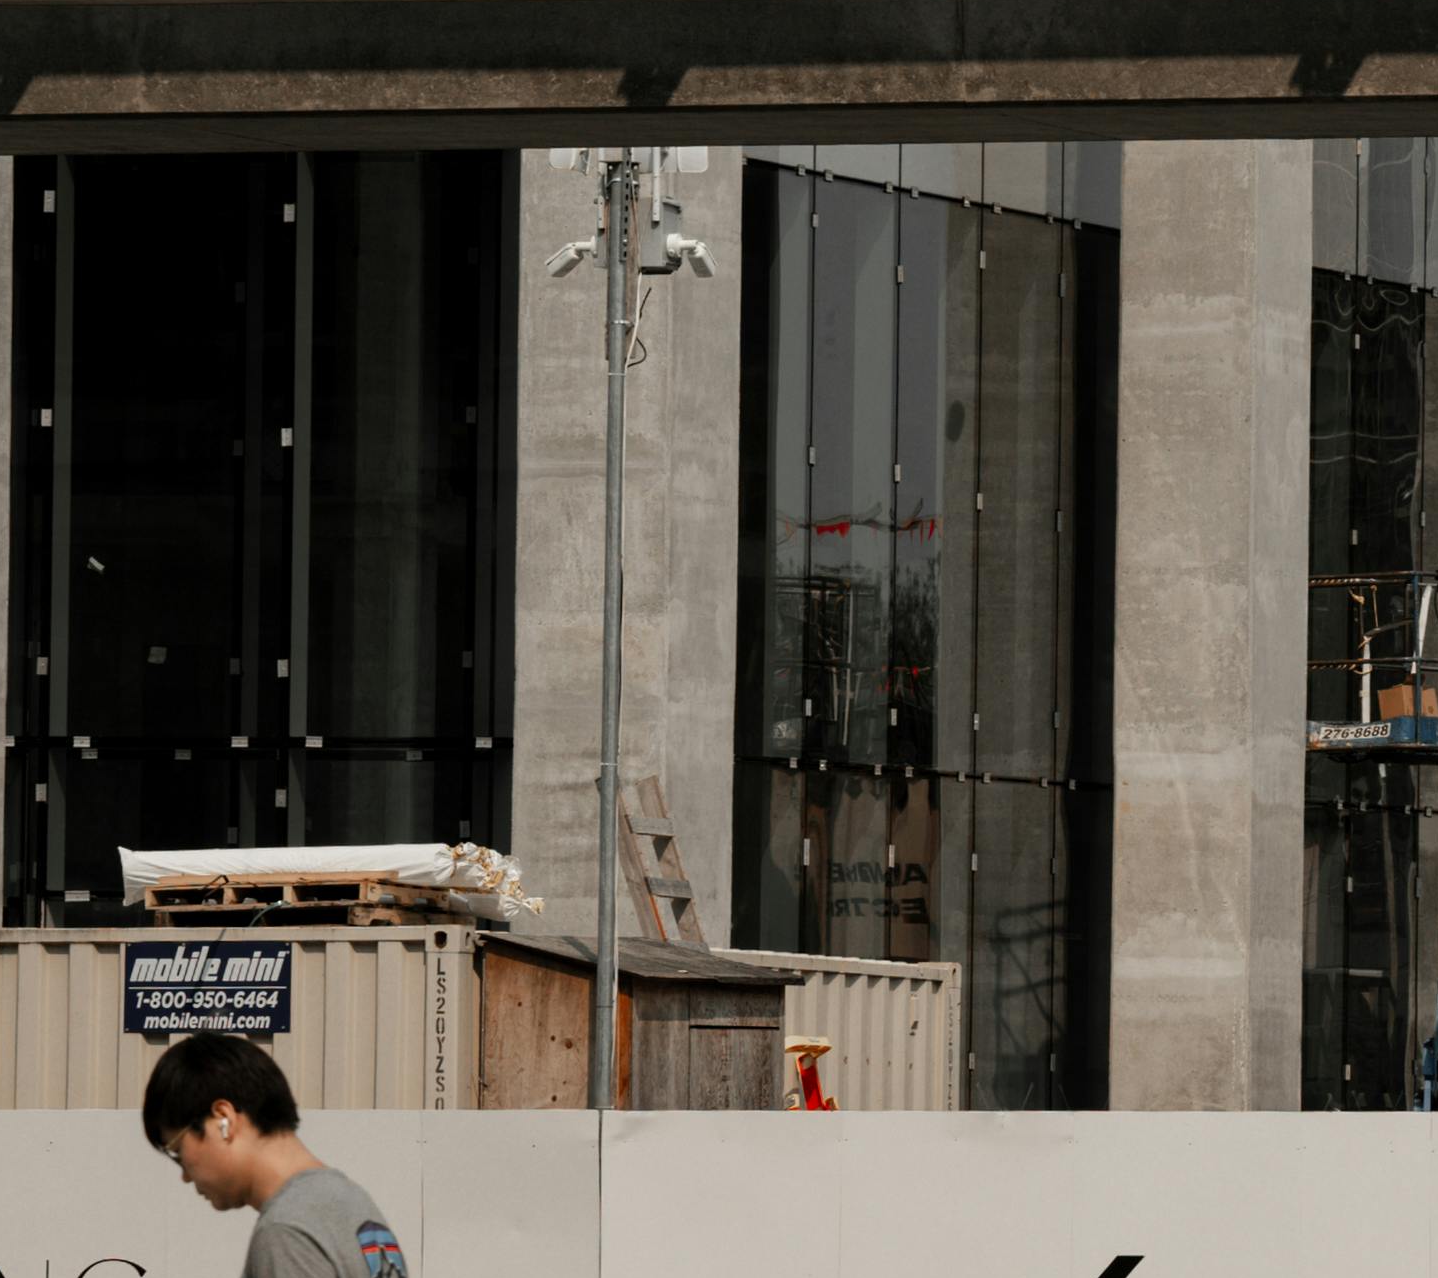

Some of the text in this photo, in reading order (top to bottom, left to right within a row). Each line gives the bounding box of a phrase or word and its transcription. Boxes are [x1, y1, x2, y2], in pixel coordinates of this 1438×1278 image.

[1321, 725, 1389, 740] 276-8688
[129, 945, 287, 982] mobile mini
[136, 991, 279, 1009] 1-800-950-6464
[143, 1011, 271, 1029] mobilemini.com
